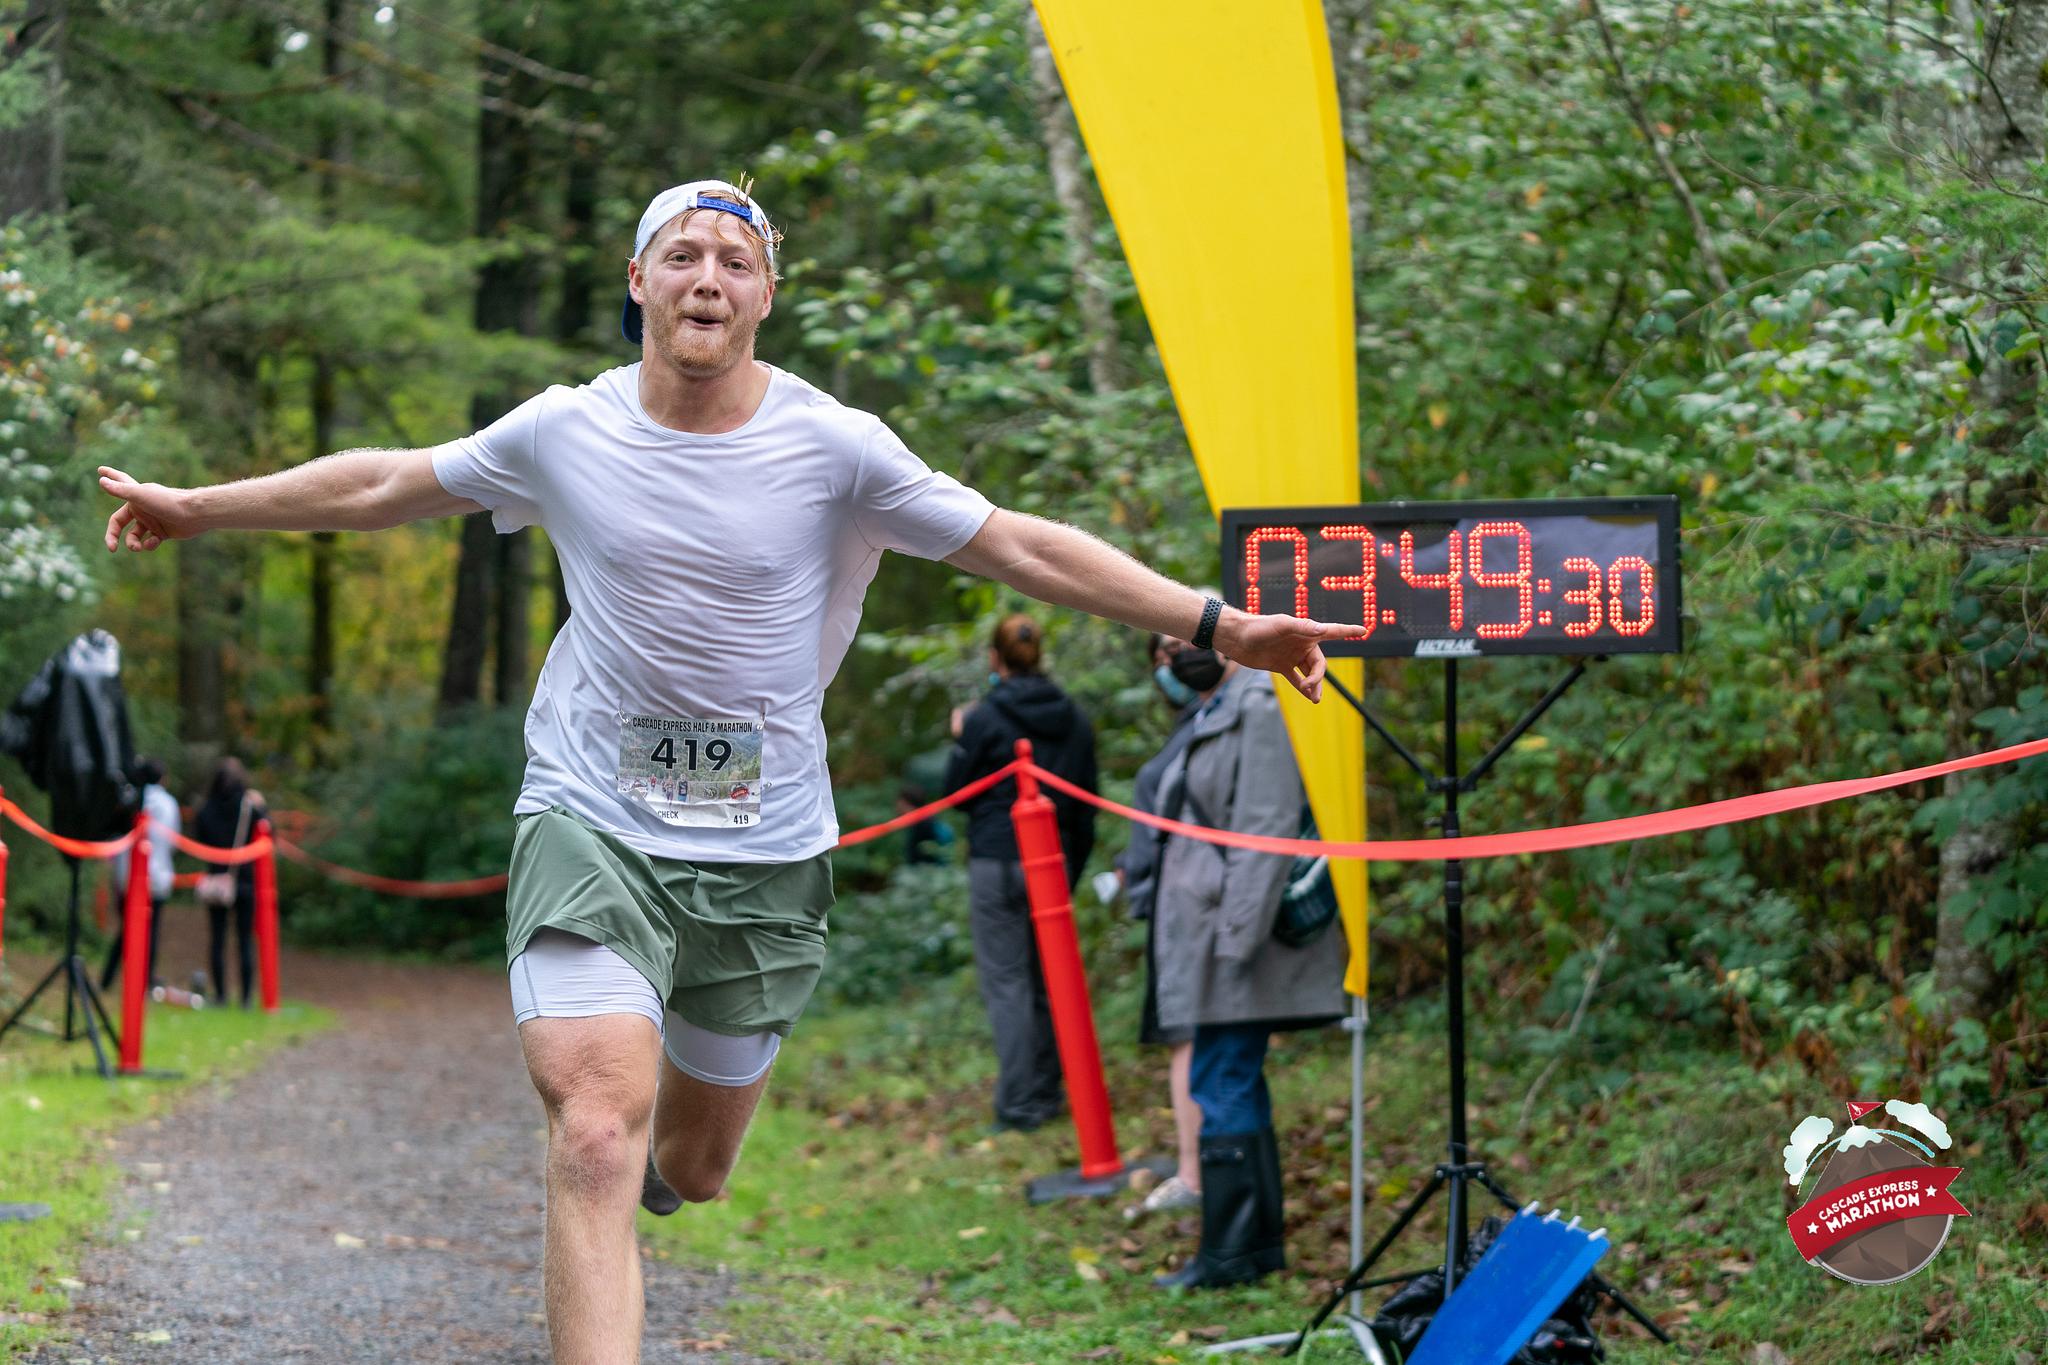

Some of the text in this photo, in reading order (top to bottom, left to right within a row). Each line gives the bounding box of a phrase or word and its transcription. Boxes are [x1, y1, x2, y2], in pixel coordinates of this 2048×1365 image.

[632, 717, 753, 733] CASCADE EXPRESS HALF & MARATHON
[650, 737, 732, 772] 419
[733, 814, 749, 825] 419
